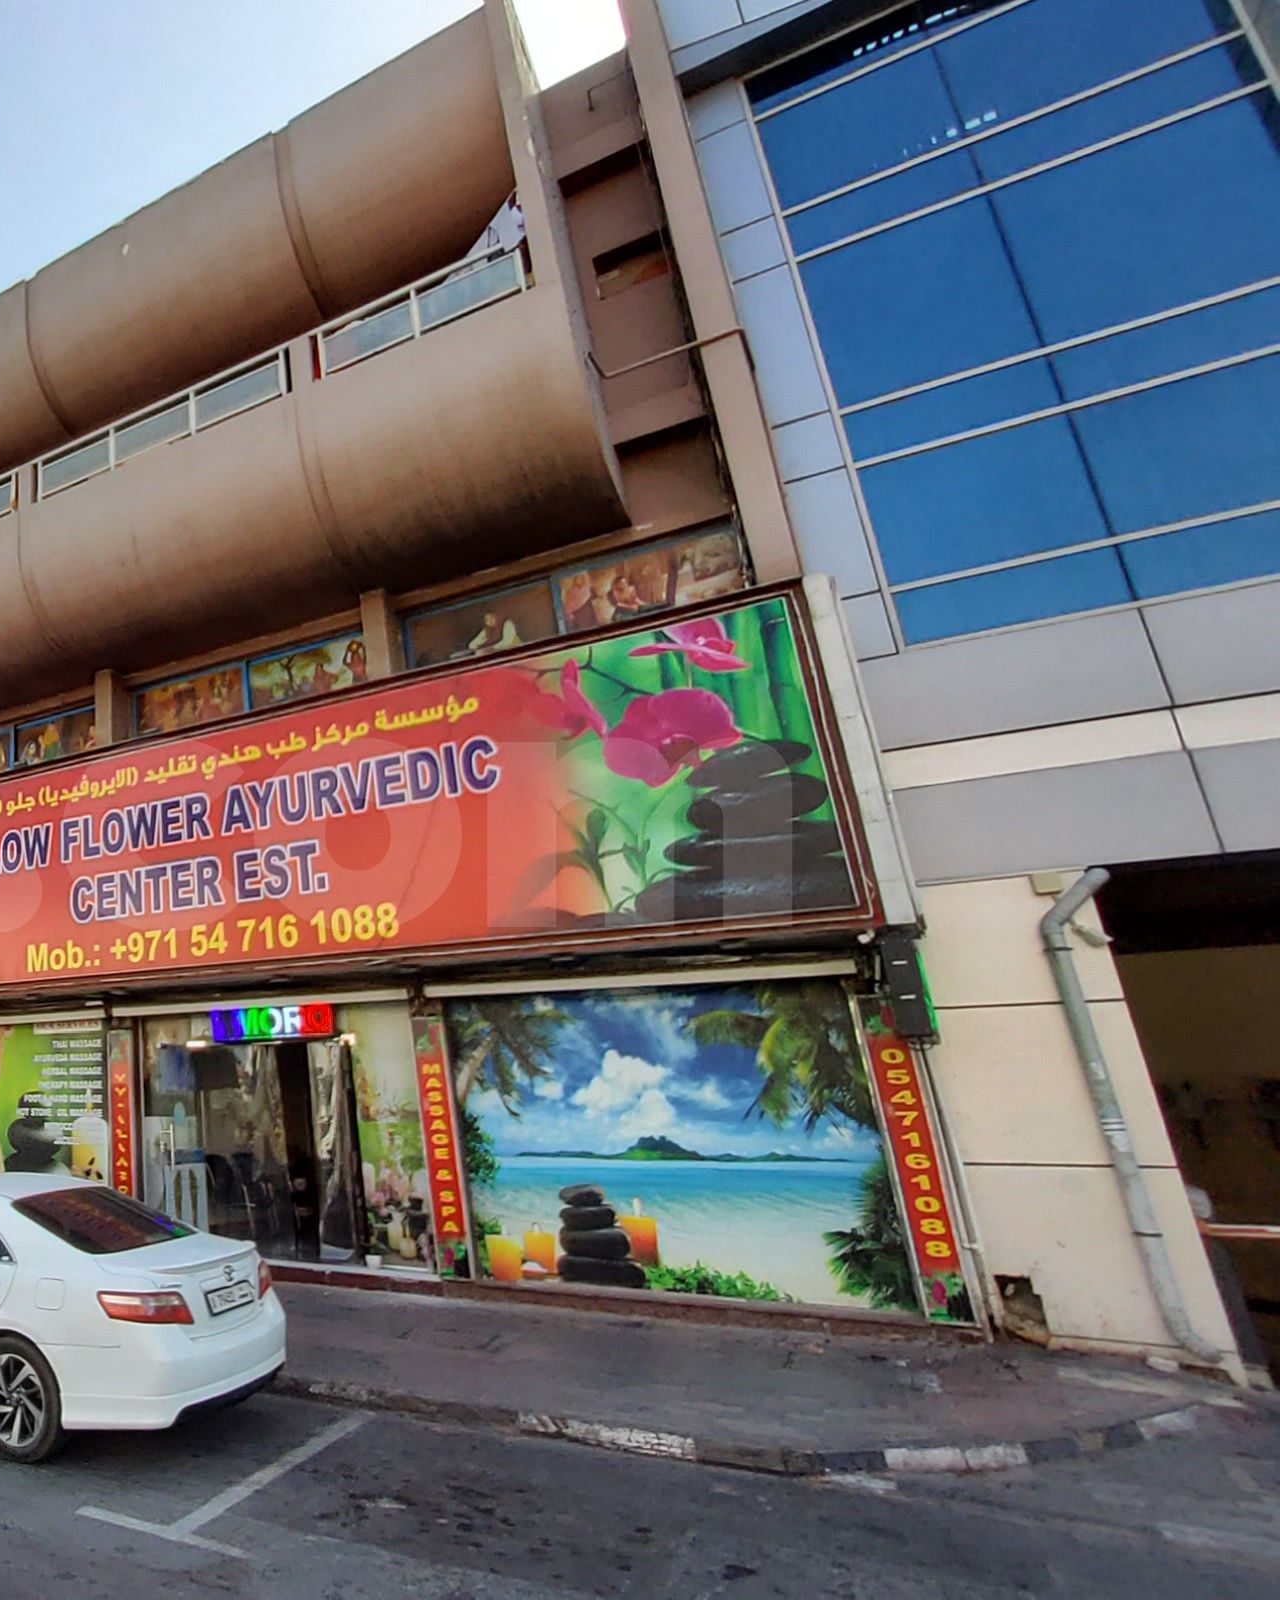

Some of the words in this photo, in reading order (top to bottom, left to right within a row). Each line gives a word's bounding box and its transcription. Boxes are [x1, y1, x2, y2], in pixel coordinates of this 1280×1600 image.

[311, 718, 369, 754] مركز
[374, 694, 479, 734] مؤسسة
[201, 743, 263, 780] هندي
[266, 733, 308, 759] طب
[59, 792, 212, 864] FLOWER
[221, 735, 502, 840] AYURVEDIC
[70, 855, 222, 925] CENTER
[234, 838, 330, 900] EST.
[109, 927, 178, 967] +971
[190, 922, 229, 957] 54
[236, 915, 300, 952] 716
[314, 901, 400, 944] 1088
[421, 1062, 451, 1162] MASSAGE
[433, 1166, 452, 1183] &
[879, 1046, 952, 1260] 0547161088
[437, 1188, 461, 1236] SPA
